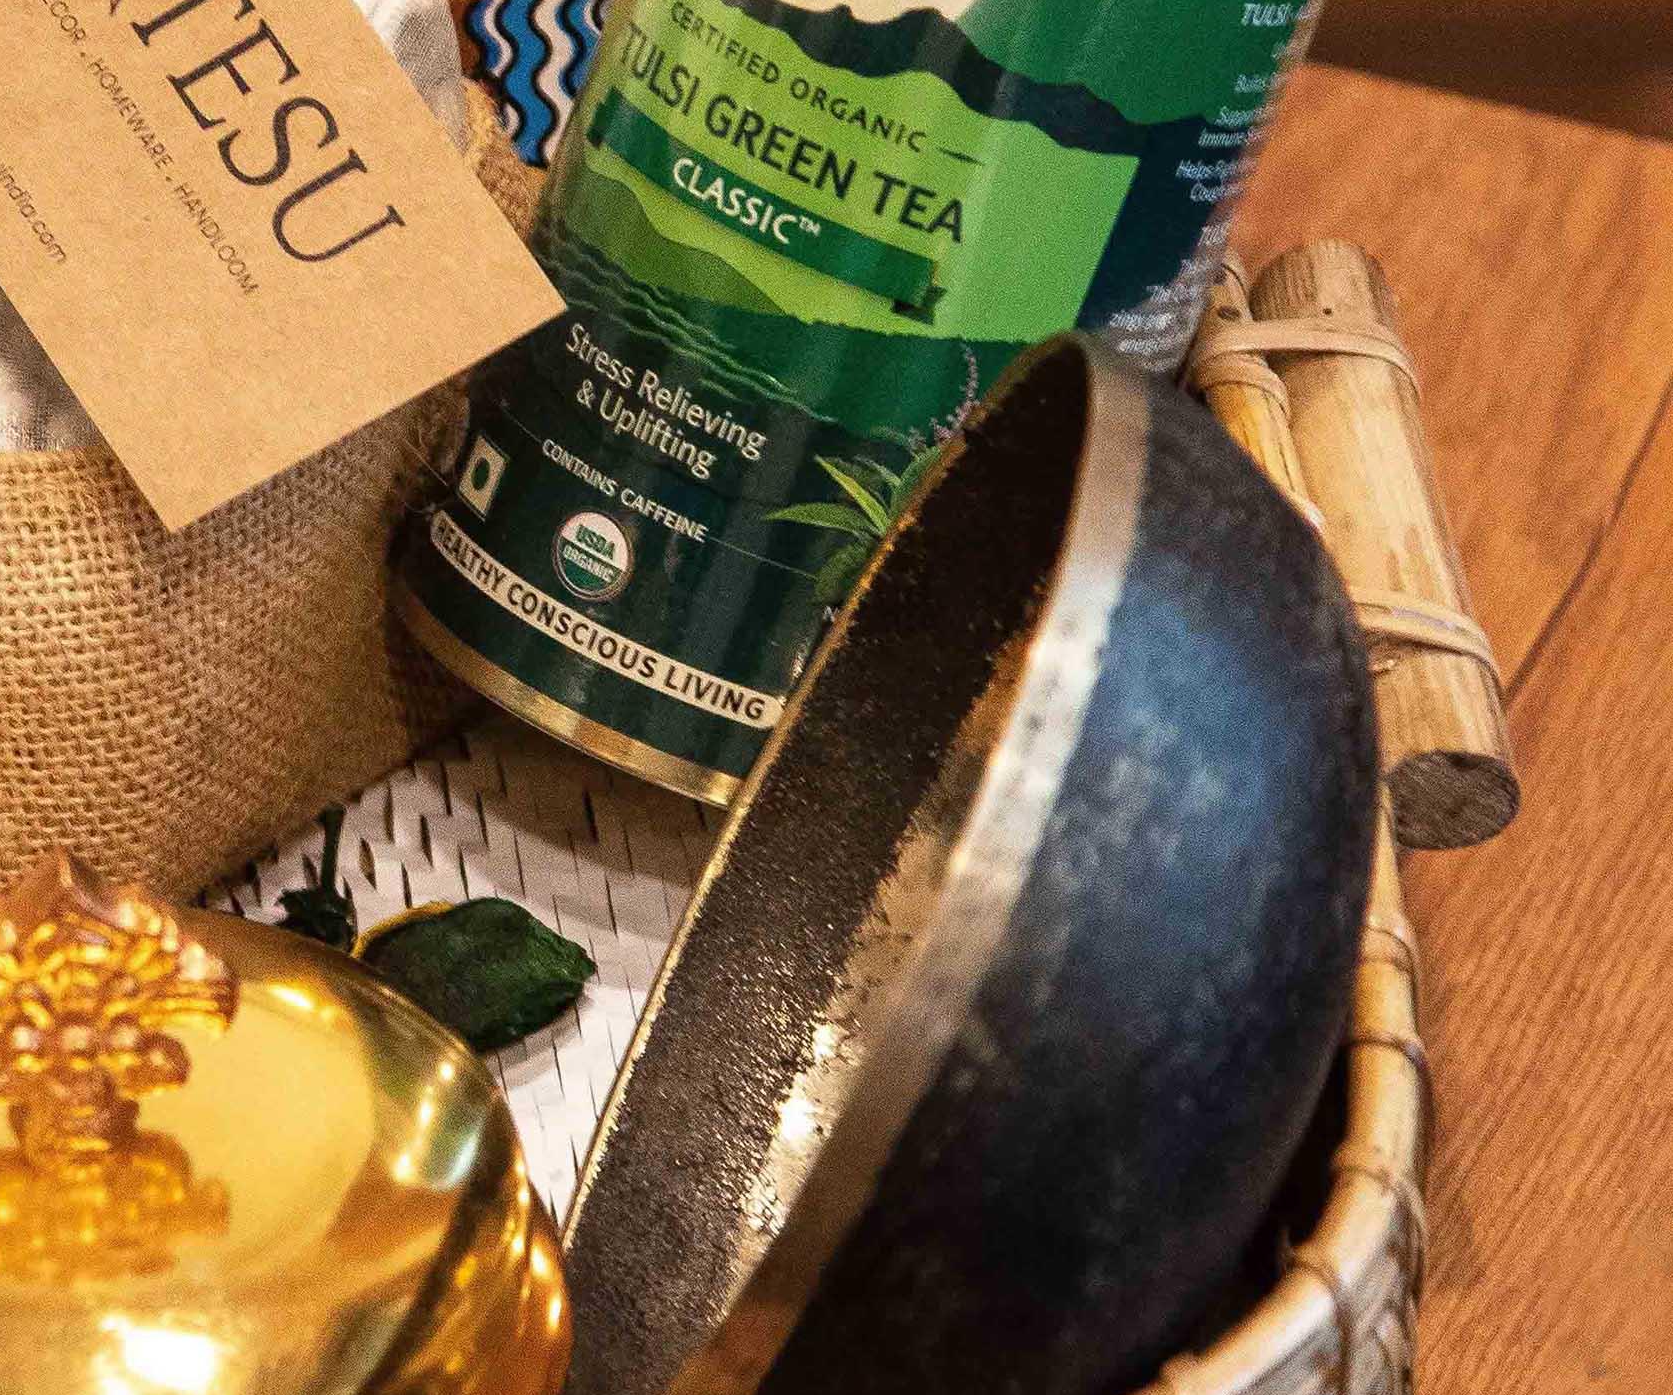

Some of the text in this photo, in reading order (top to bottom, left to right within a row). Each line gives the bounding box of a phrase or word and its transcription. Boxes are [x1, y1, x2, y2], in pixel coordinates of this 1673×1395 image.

[621, 21, 964, 244] TULSI GREEN TEA
[669, 3, 929, 154] CERTIFIED ORGANIC
[88, 60, 174, 172] HOMEWARE
[175, 183, 260, 295] HANDLOOM
[565, 322, 768, 463] Stress Relieving
[576, 380, 718, 481] & Uplifting
[541, 437, 710, 545] CONTAINS CAFFEINE
[576, 522, 617, 561] USDA
[436, 518, 766, 722] HEALTHY CONSCIOUS LIVING
